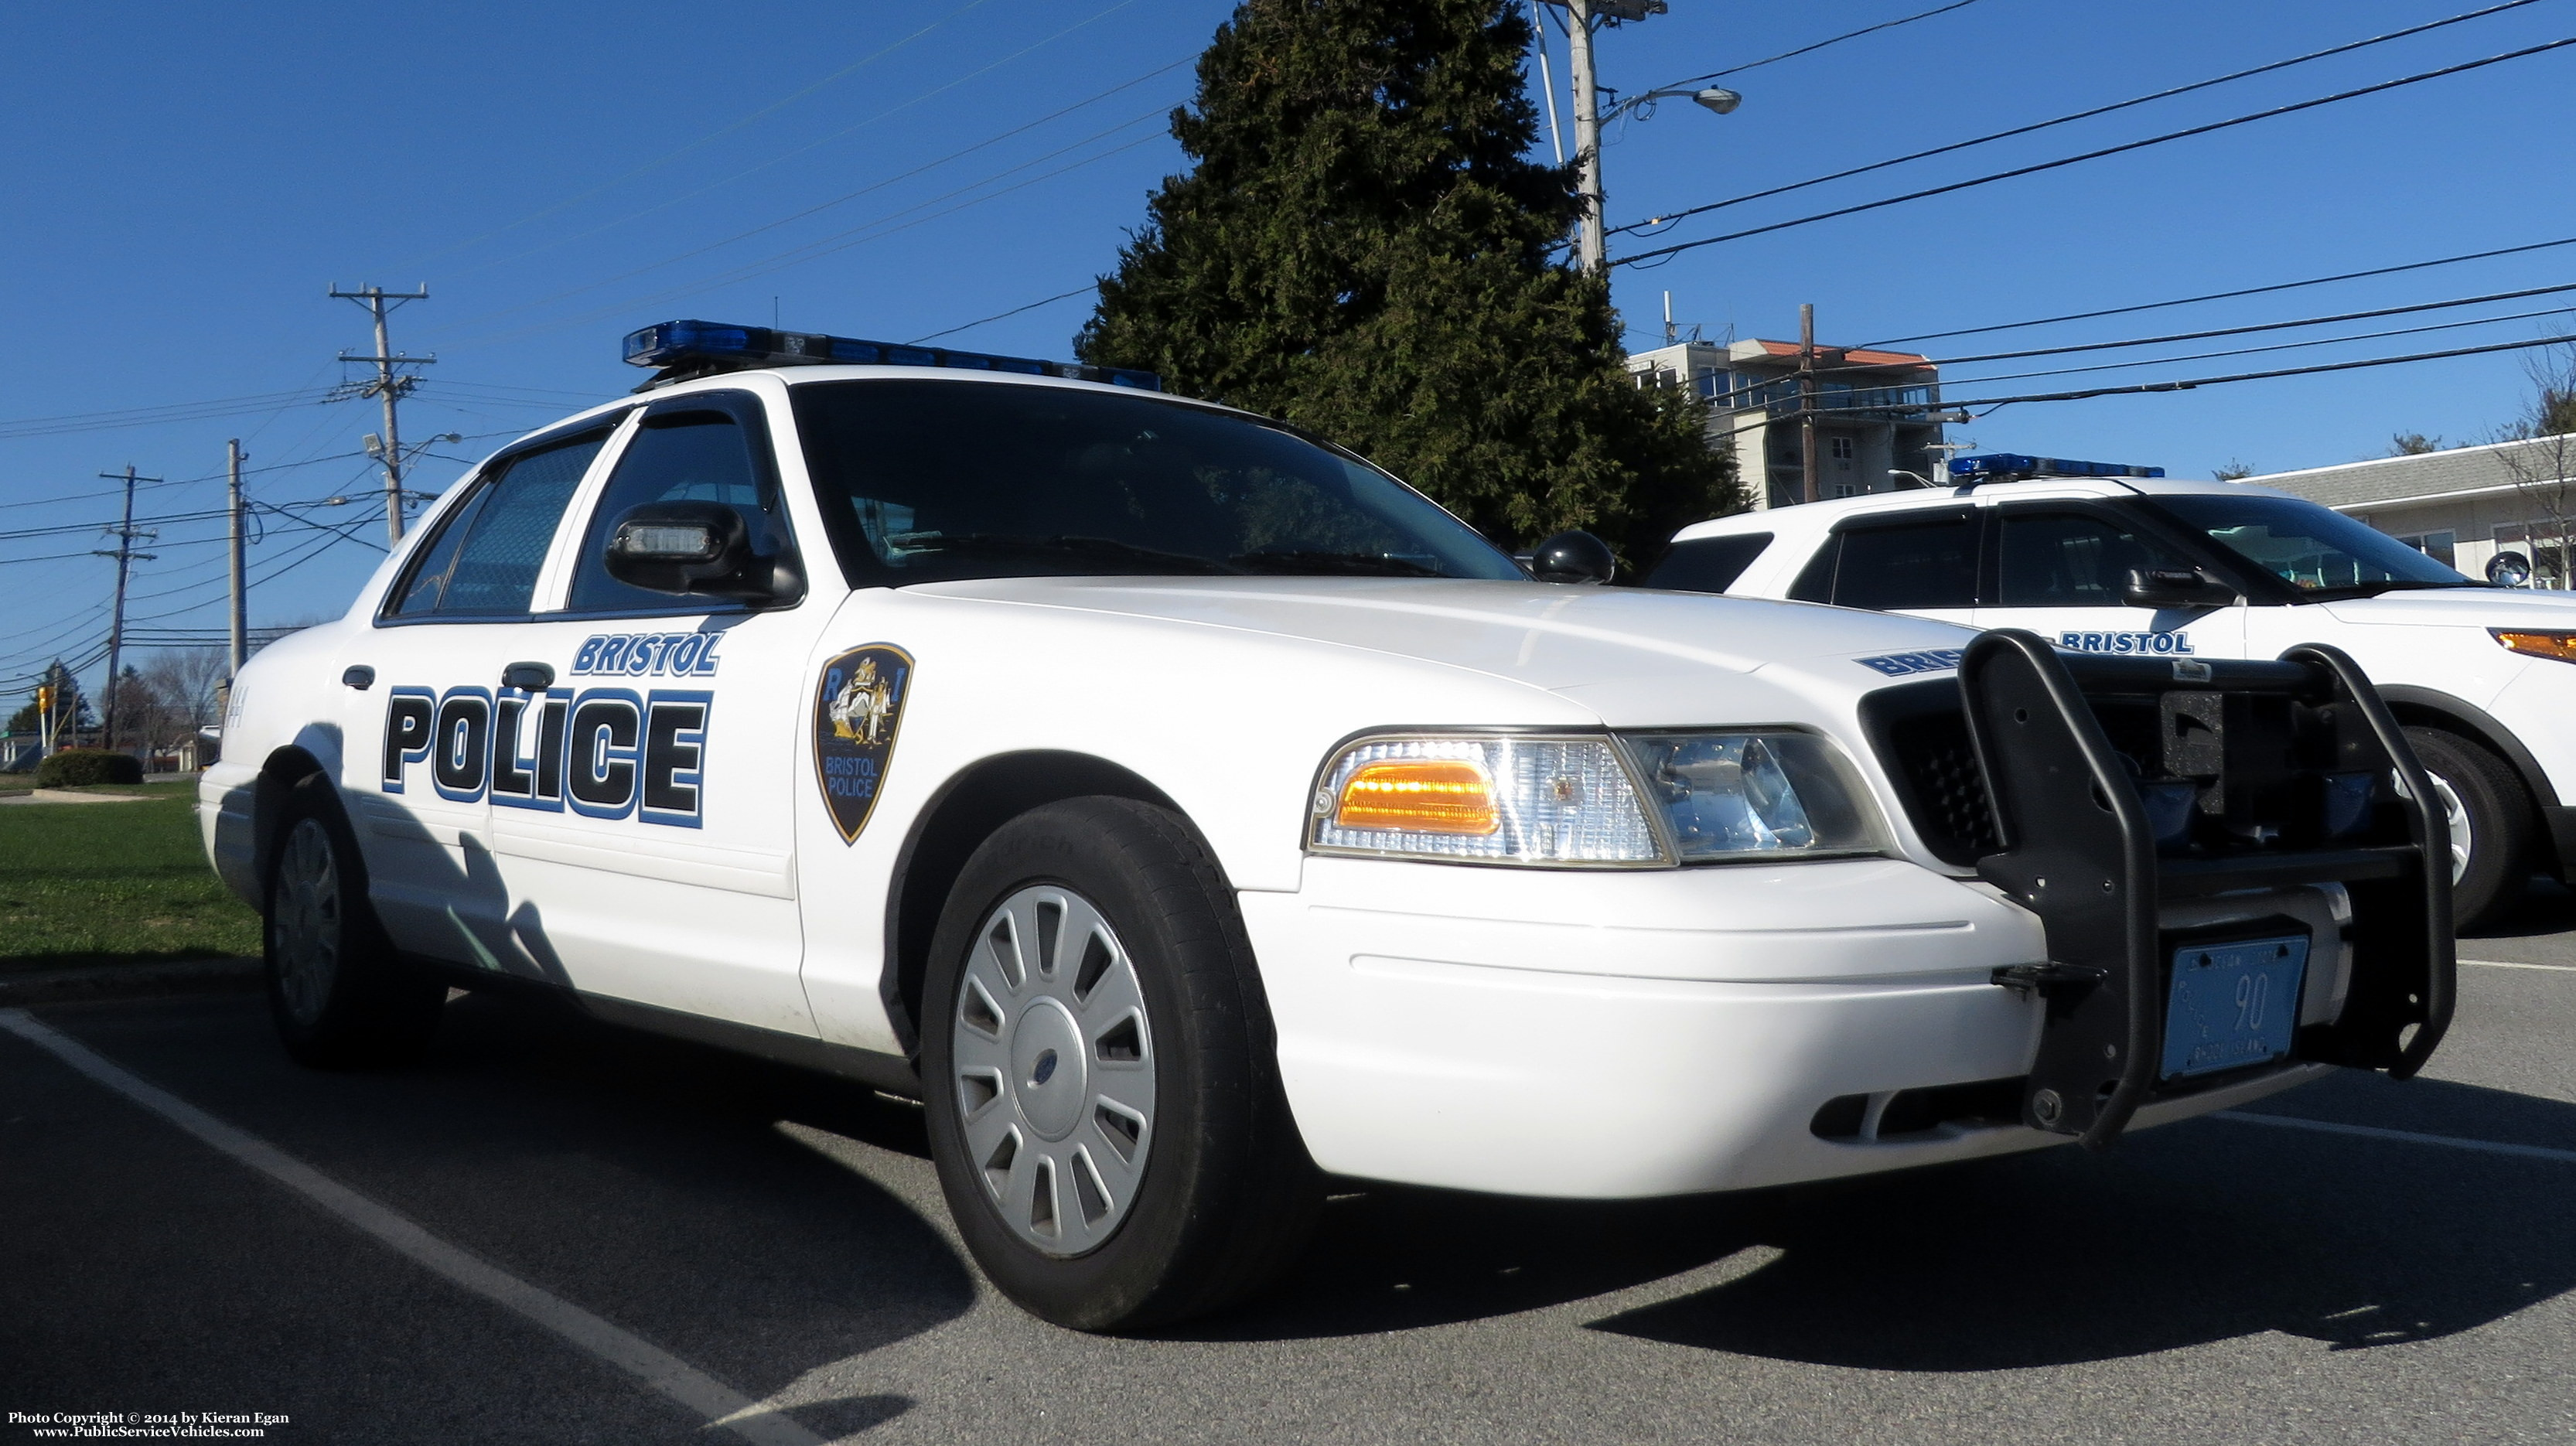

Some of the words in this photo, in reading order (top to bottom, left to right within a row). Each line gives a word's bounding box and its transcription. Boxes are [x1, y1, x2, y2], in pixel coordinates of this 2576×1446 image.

[570, 631, 725, 677] BRISTOL
[2059, 631, 2195, 655] BRISTOL
[1851, 648, 1965, 677] BRIS
[383, 685, 714, 830] POLICE
[825, 756, 878, 777] BRISTOL
[828, 777, 873, 798] POLICE
[2234, 973, 2268, 1031] 90
